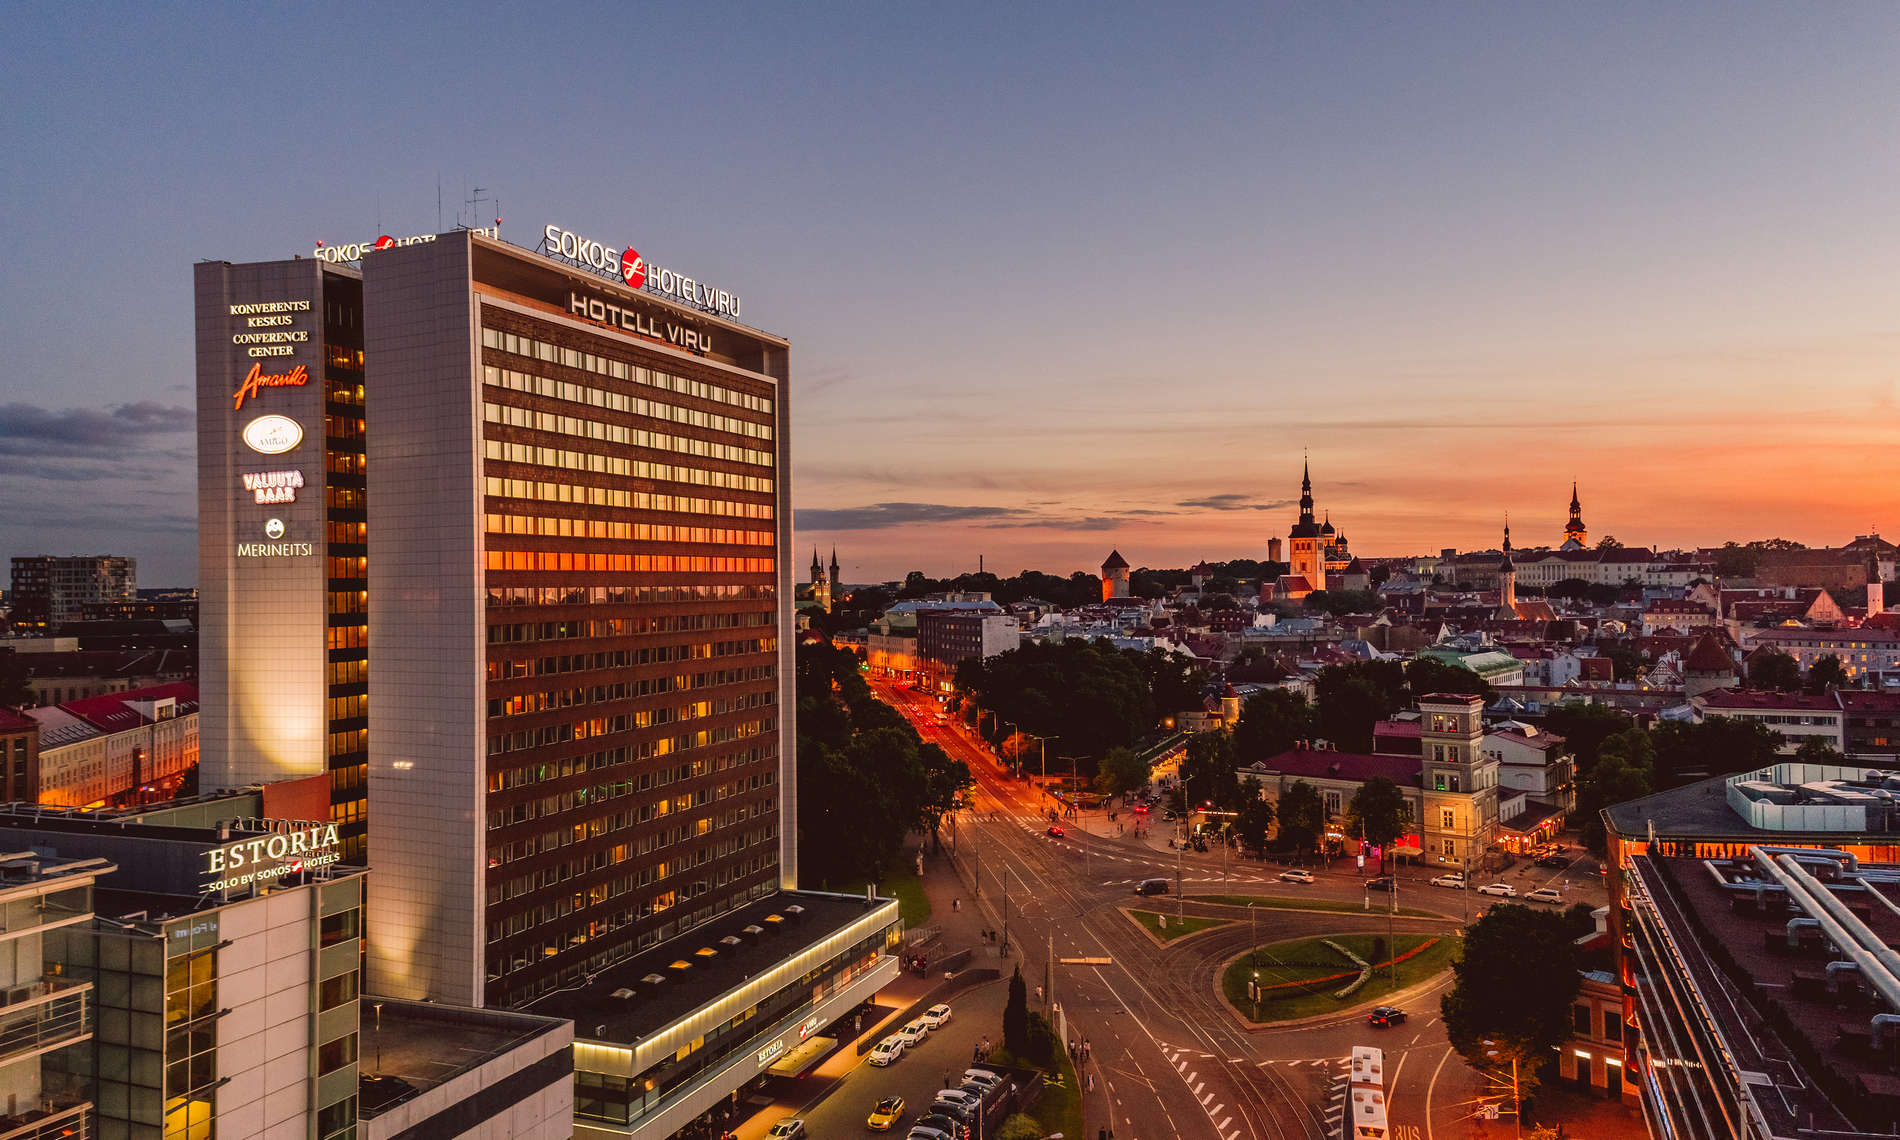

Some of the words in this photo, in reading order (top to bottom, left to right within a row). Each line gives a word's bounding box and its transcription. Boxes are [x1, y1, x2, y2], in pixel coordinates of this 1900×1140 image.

[544, 225, 618, 274] SOKOS
[648, 263, 702, 304] HOTEL
[702, 285, 741, 317] VIRU
[230, 301, 310, 315] KONVERENTSI
[248, 315, 292, 327] KESKUS
[571, 291, 662, 338] HOTELL
[666, 323, 712, 353] VIRU
[233, 331, 308, 344] CONFERENCE
[248, 345, 293, 357] CENTER
[233, 362, 308, 410] Amarillo
[243, 470, 304, 491] VALUUTA
[255, 487, 296, 504] BAAR
[237, 543, 312, 557] MERINEITSI
[208, 823, 340, 874] ESTORIA
[208, 877, 238, 892] SOLO
[240, 873, 254, 885] BY
[257, 864, 291, 881] SOKOS
[303, 852, 340, 868] HOTELS
[1395, 1124, 1421, 1140] BUS
